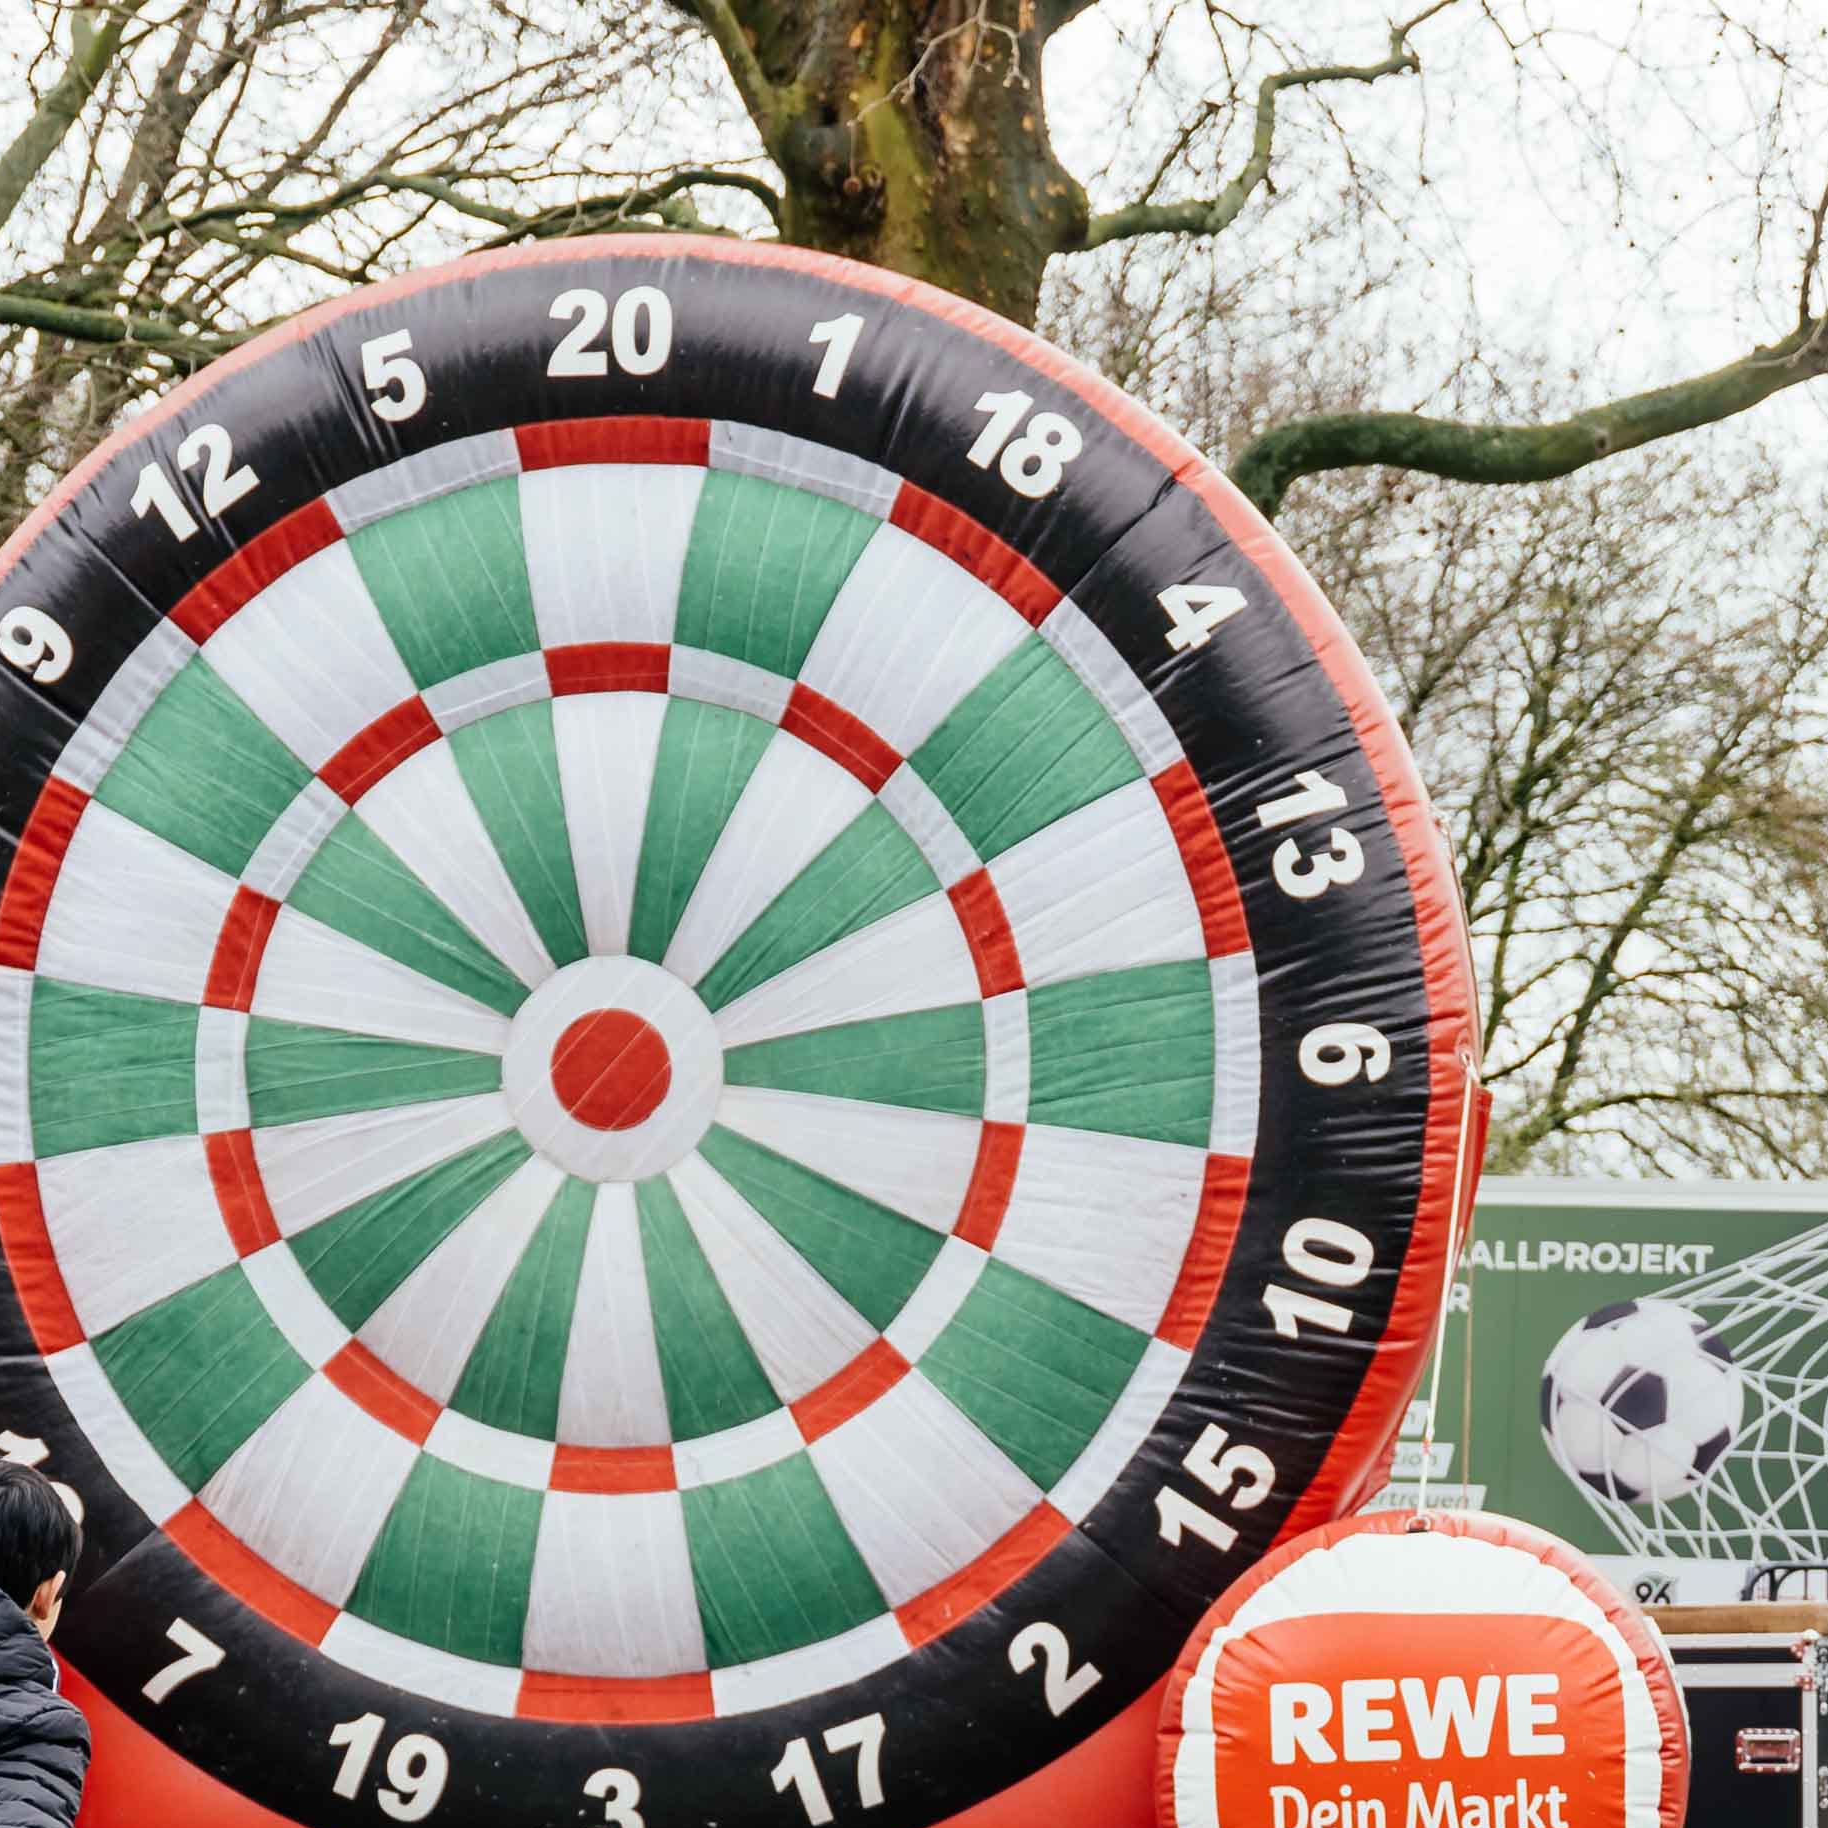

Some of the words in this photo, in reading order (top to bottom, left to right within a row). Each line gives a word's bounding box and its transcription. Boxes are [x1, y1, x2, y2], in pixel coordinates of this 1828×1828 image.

[361, 329, 427, 422] 5
[547, 286, 673, 377] 20
[808, 314, 864, 399] 1
[130, 423, 260, 543] 12
[966, 389, 1083, 499] 18
[1156, 582, 1247, 652] 4
[1256, 770, 1366, 899] 13
[1262, 1217, 1374, 1340] 10
[1154, 1422, 1276, 1552] 15
[142, 1618, 225, 1705] 7
[1008, 1622, 1103, 1717] 2
[328, 1712, 449, 1823] 19
[771, 1712, 886, 1827] 17
[1269, 1672, 1566, 1765] REWE
